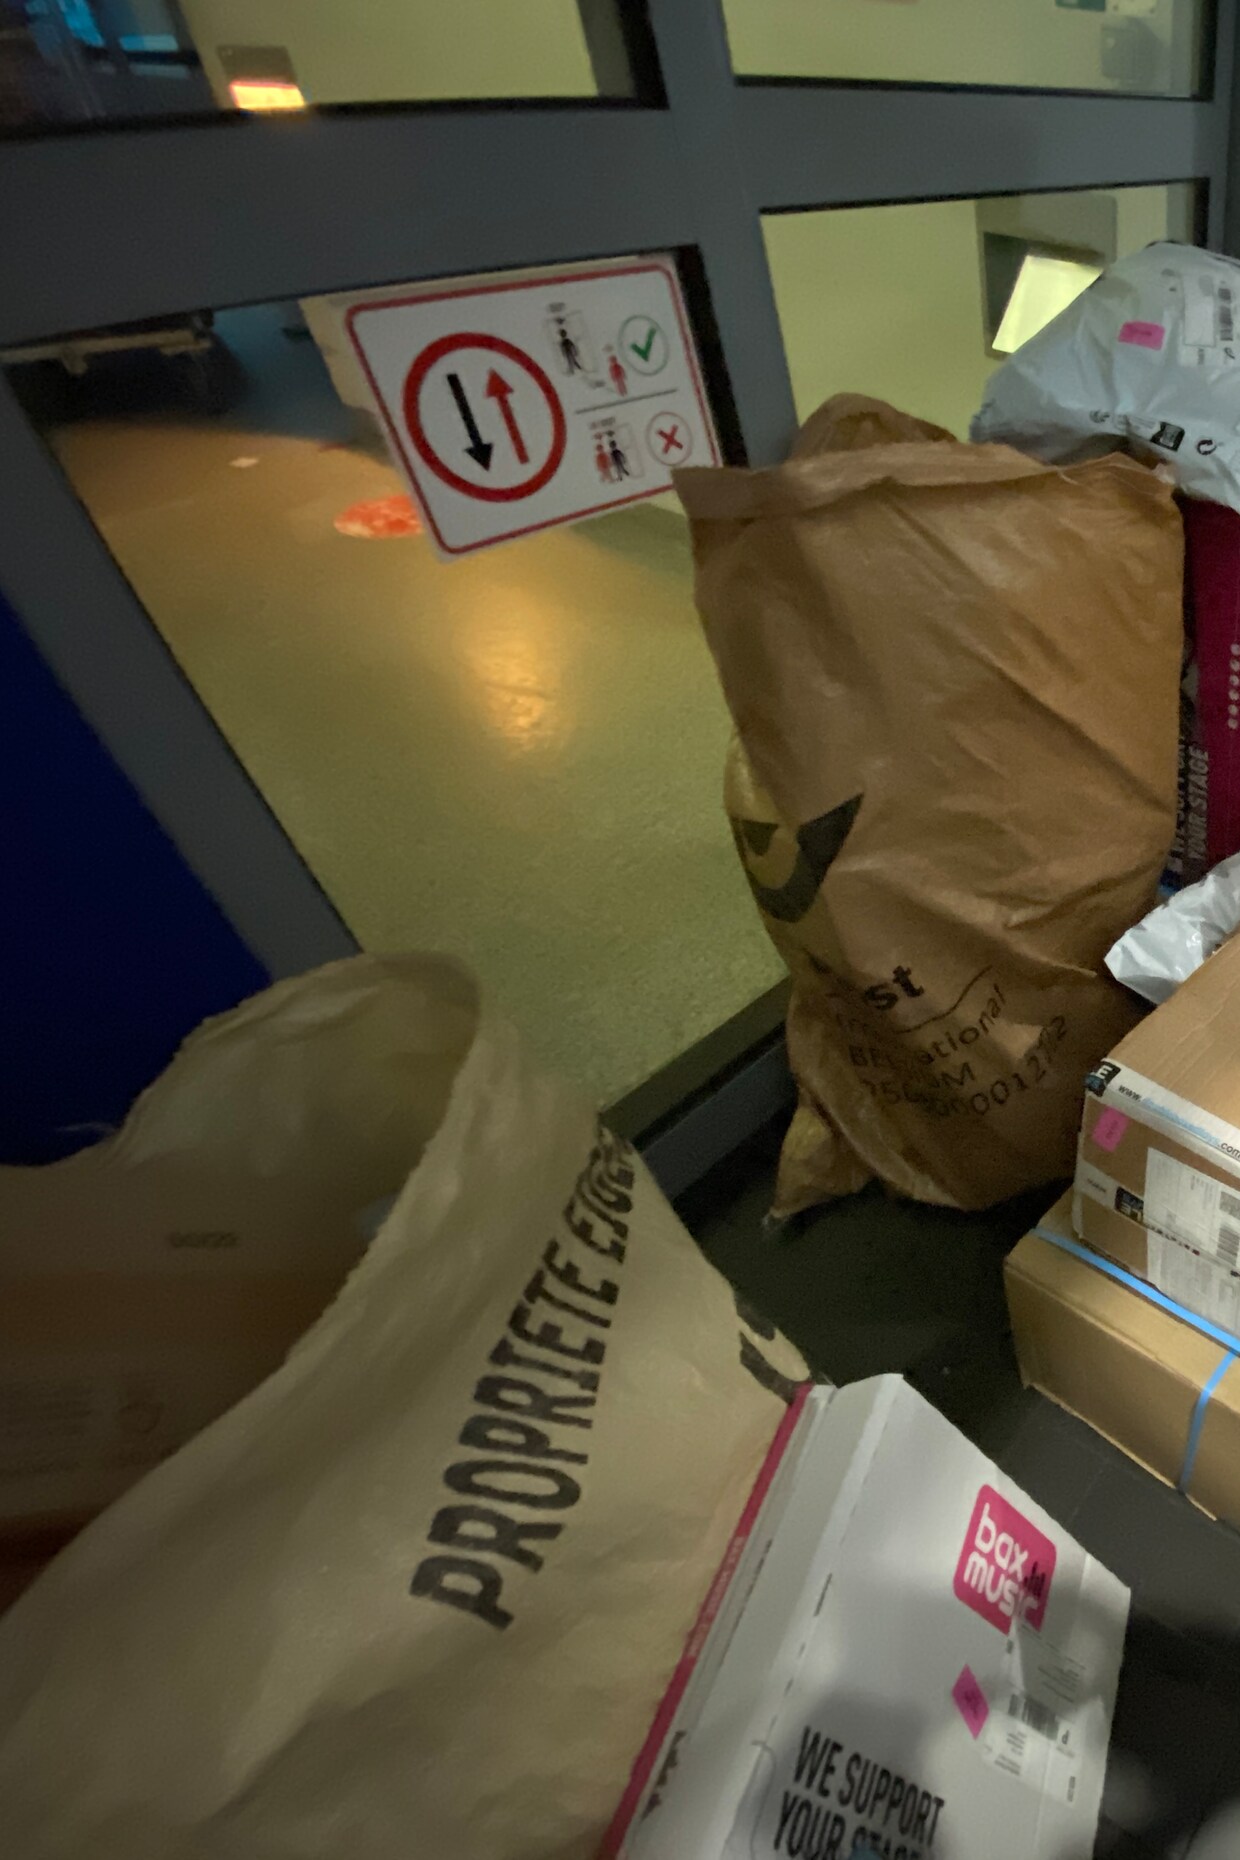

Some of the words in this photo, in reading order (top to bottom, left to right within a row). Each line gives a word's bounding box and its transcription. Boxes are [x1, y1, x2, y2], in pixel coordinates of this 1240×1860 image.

[1188, 745, 1209, 808] STAGE
[409, 1237, 620, 1632] PROPRIETE
[974, 1502, 1029, 1582] bax
[773, 1790, 846, 1860] YOUR
[793, 1725, 843, 1797] WE
[838, 1752, 945, 1848] SUPPORT
